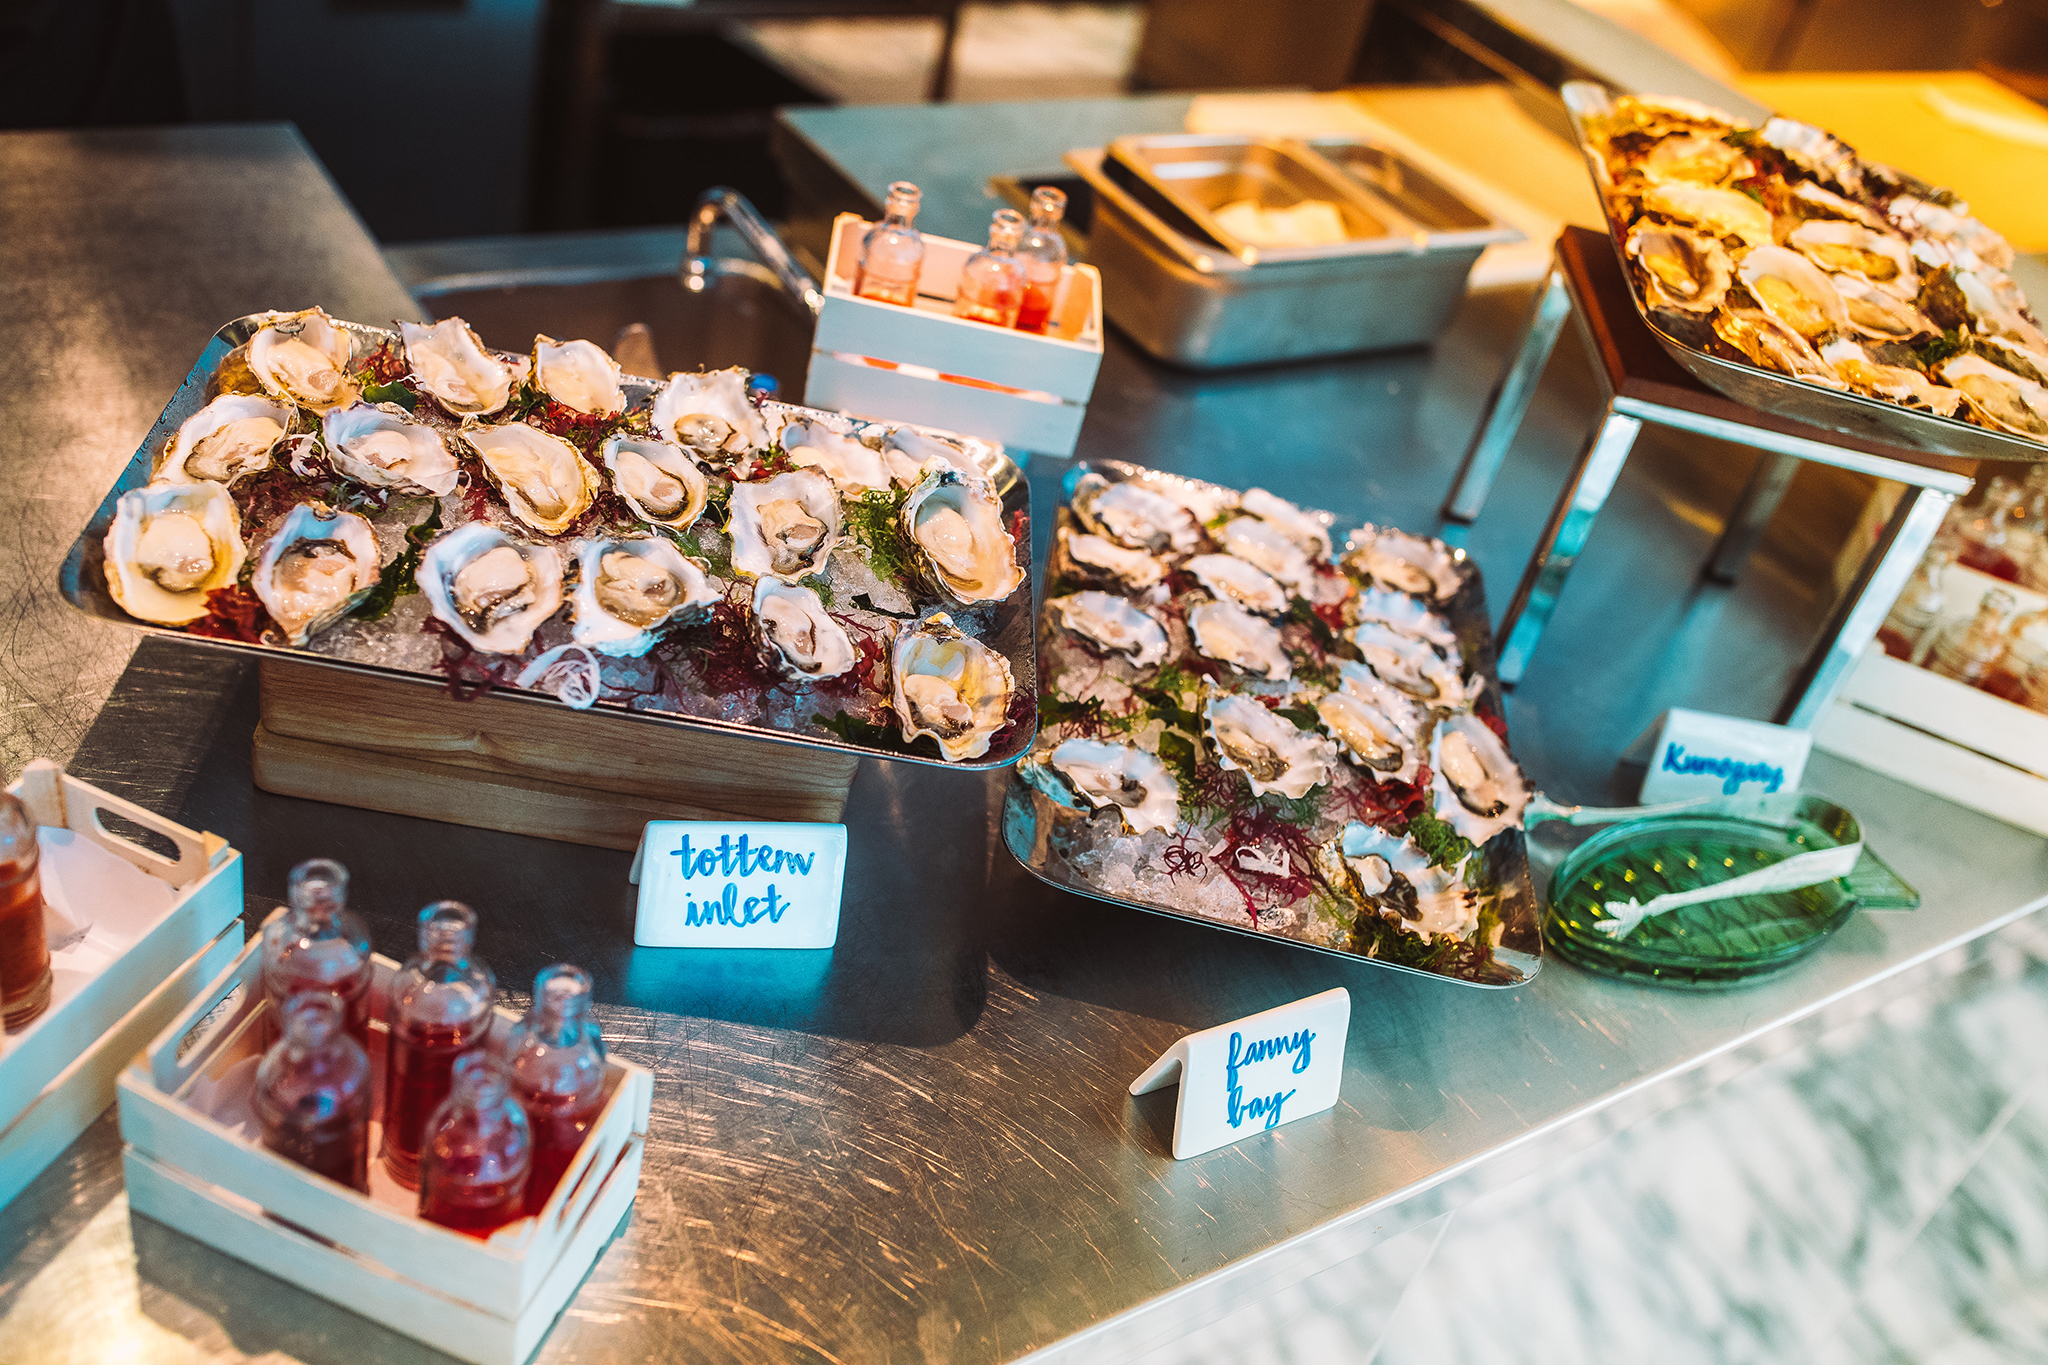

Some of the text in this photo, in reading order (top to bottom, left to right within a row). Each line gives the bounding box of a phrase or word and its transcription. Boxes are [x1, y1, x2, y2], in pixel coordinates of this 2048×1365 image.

[684, 882, 791, 928] inlet
[1226, 1028, 1317, 1092] fanny
[1226, 1085, 1297, 1130] bay
